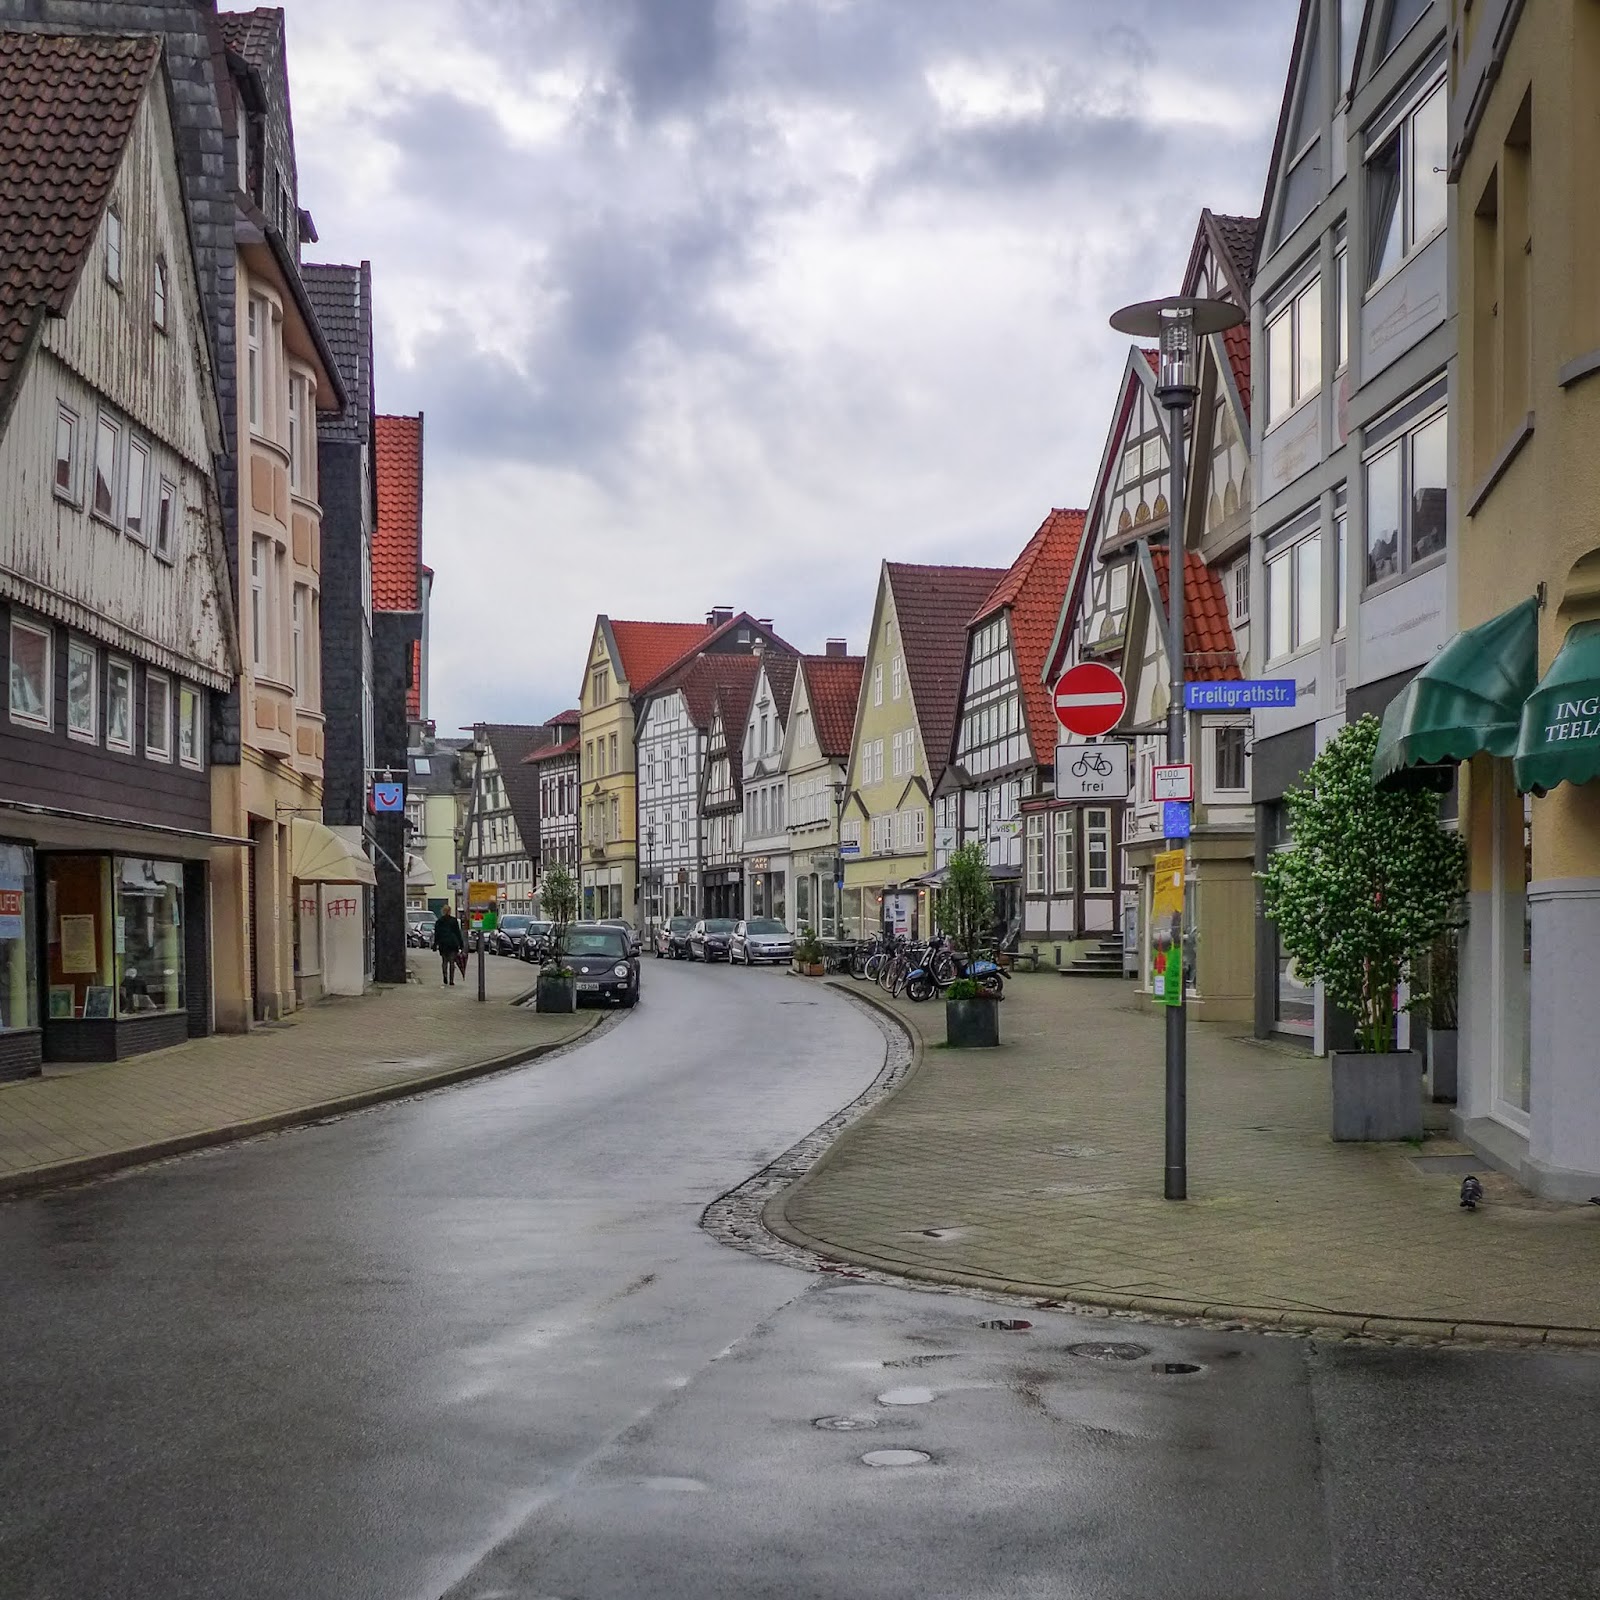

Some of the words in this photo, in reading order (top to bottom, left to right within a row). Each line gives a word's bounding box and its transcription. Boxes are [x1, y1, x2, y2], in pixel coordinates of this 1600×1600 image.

[1191, 687, 1289, 707] Freiligrathstr.
[1555, 697, 1600, 720] ING
[1082, 780, 1104, 792] frei
